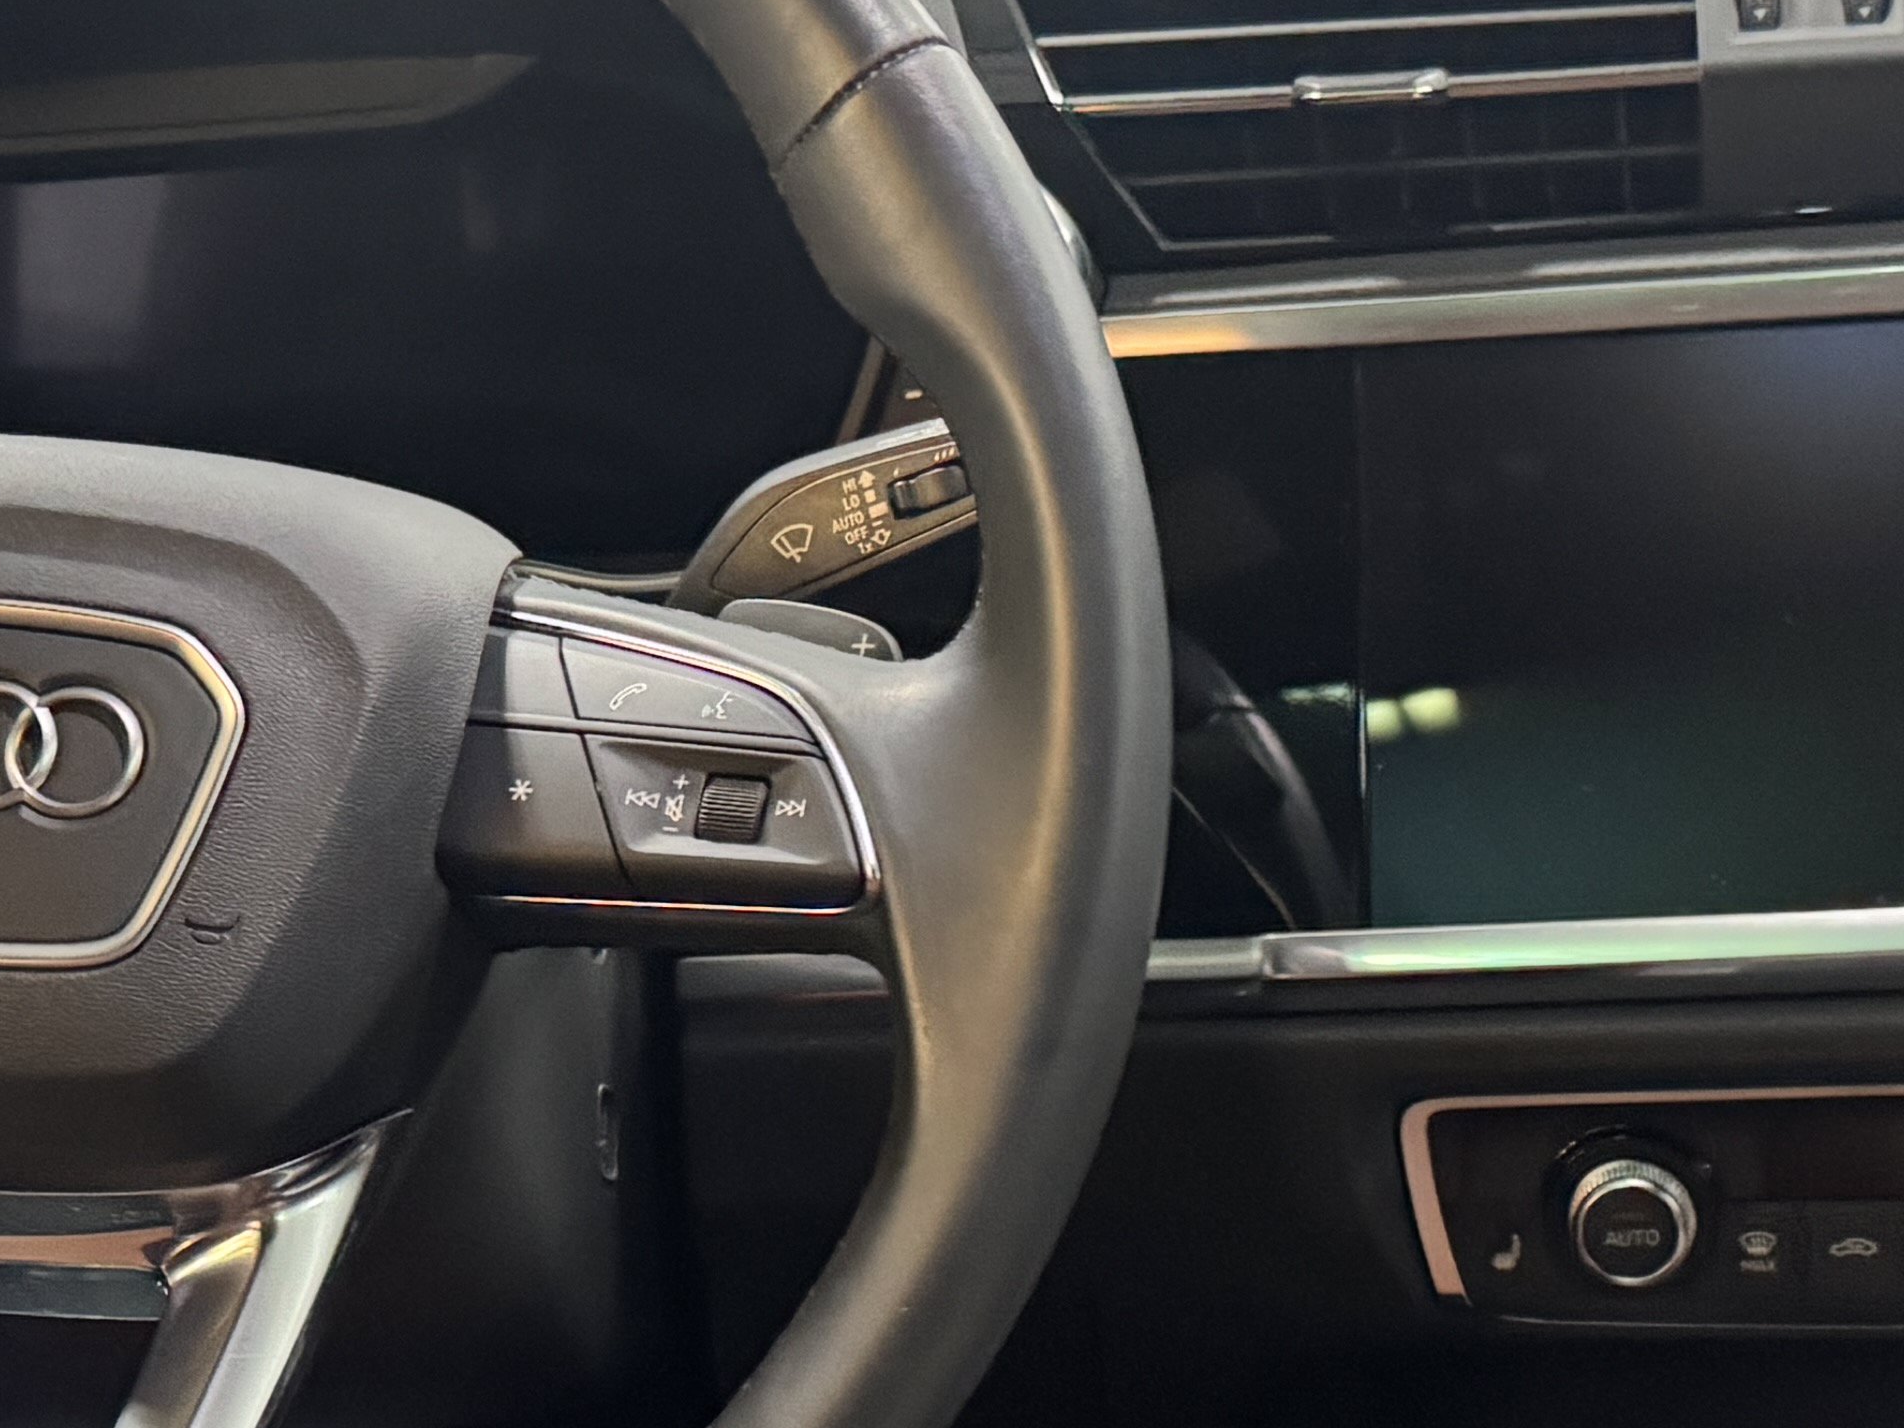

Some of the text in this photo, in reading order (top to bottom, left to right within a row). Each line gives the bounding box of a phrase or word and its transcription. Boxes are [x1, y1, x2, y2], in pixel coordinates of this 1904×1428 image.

[842, 477, 858, 494] HI
[842, 494, 861, 511] LO
[832, 511, 865, 534] AUTO
[844, 525, 869, 545] OFF
[1603, 1229, 1661, 1247] AUTO
